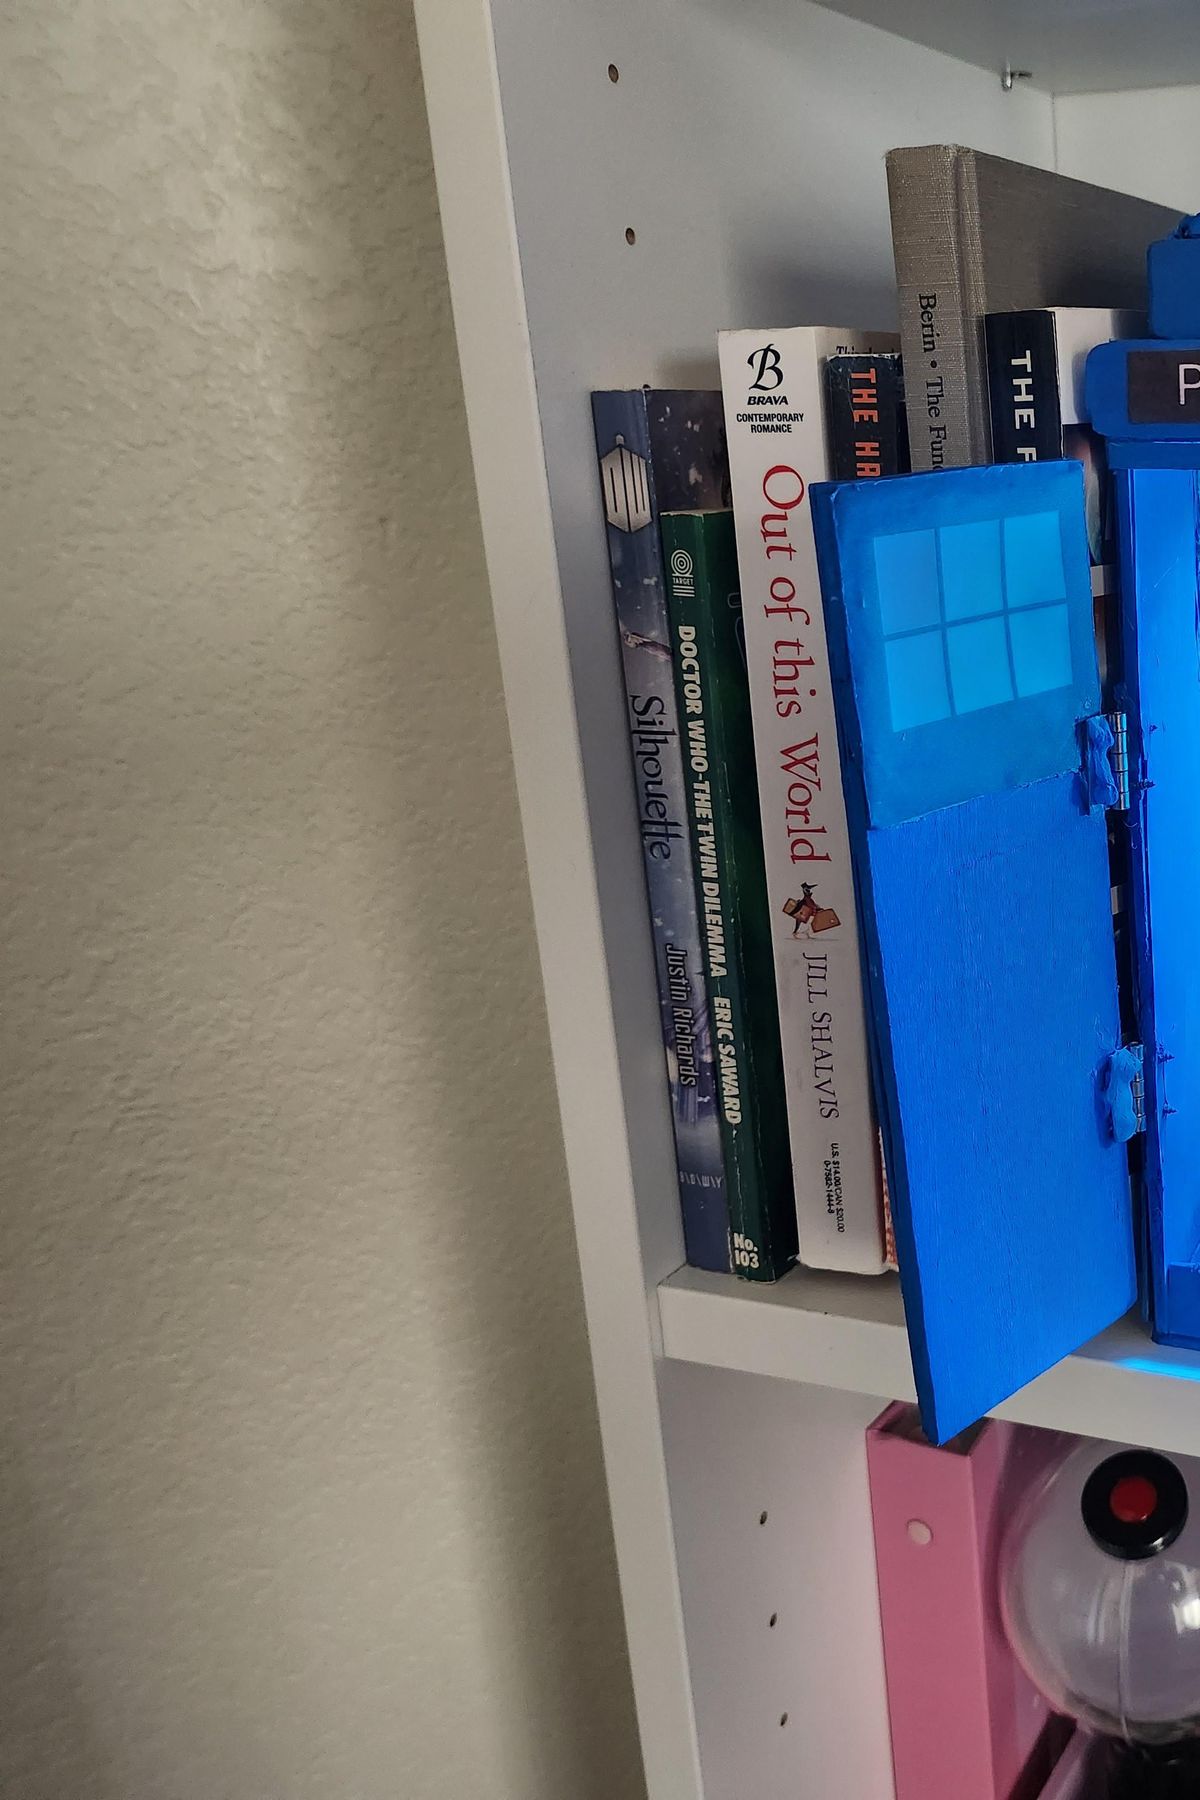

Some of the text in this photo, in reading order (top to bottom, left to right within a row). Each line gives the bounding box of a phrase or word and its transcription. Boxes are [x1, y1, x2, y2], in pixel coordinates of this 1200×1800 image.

[919, 293, 941, 353] Berin
[736, 413, 804, 424] CONTEMPORARY
[747, 396, 789, 406] BRAVA
[851, 368, 878, 423] THE
[926, 376, 945, 418] The
[1011, 350, 1036, 430] THE
[751, 424, 793, 434] ROMANCE
[672, 577, 694, 585] TARGET
[678, 625, 703, 714] DOCTOR
[760, 465, 832, 864] Out of this World
[629, 694, 685, 860] Silhouette
[697, 818, 719, 880] TWIN
[702, 881, 729, 978] DILEMMA
[665, 943, 697, 1087] Justin Richards
[713, 996, 733, 1041] ERIC
[803, 952, 839, 1119] JILL SHALVIS
[718, 1040, 742, 1125] SAWARD
[733, 1233, 758, 1252] No.
[734, 1251, 759, 1269] 103
